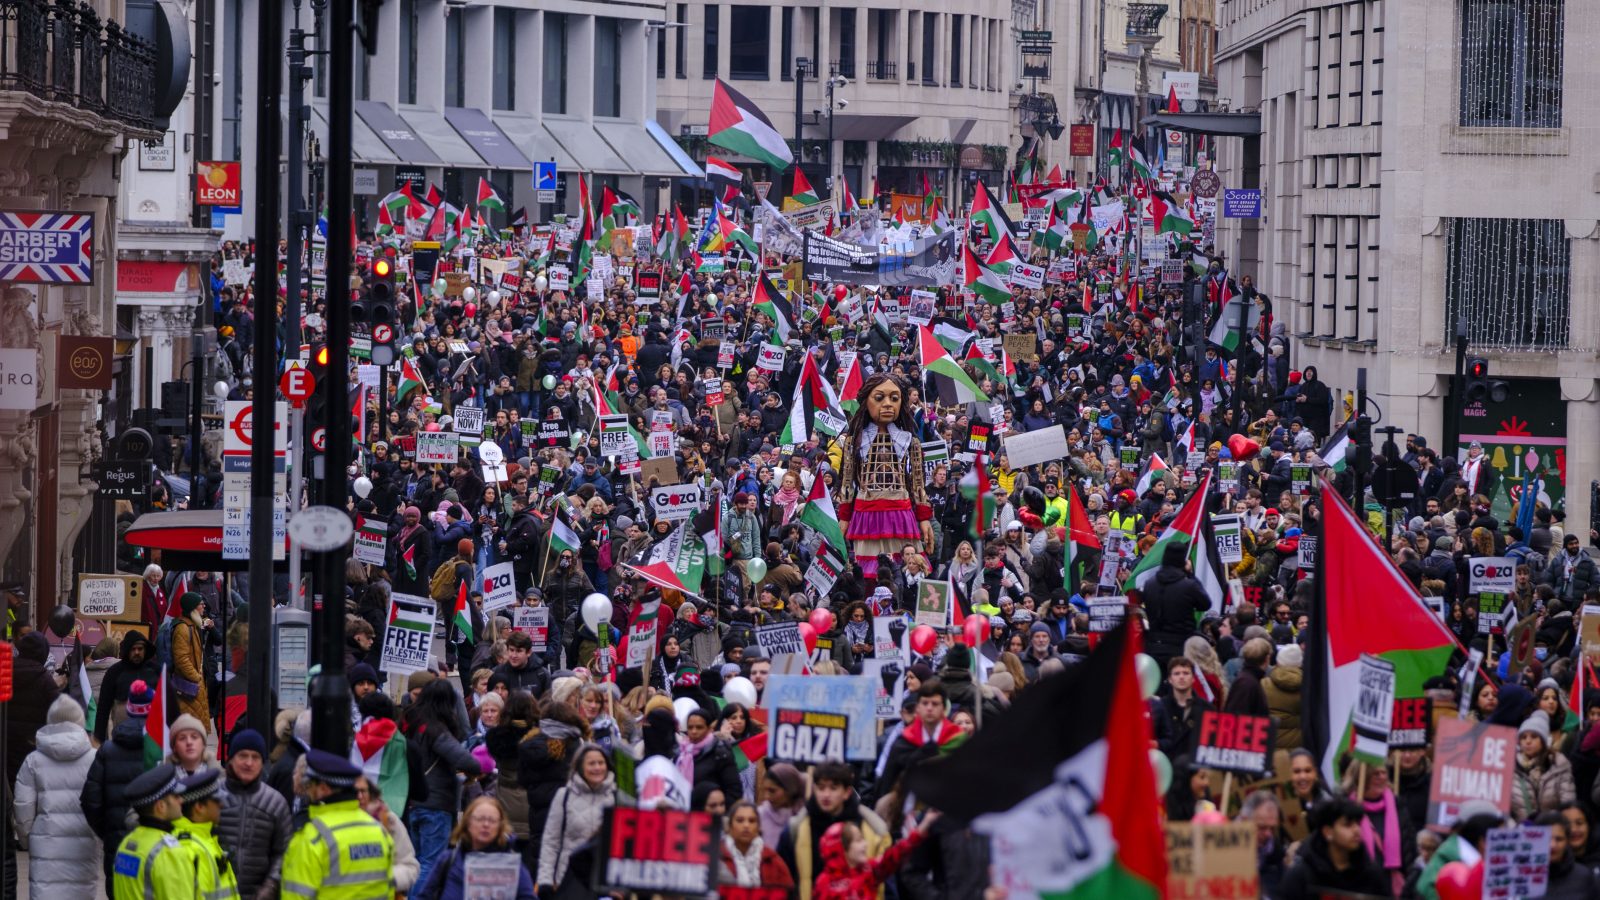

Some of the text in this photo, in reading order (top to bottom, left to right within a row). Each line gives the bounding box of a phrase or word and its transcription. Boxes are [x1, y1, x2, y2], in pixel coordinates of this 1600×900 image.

[200, 188, 236, 199] LEON
[1226, 191, 1260, 200] Scotts
[1, 231, 71, 248] ARBER
[808, 237, 848, 255] incomplete
[0, 247, 58, 263] SHOP
[808, 246, 819, 255] the
[821, 247, 850, 261] freedom
[860, 257, 873, 265] the
[551, 270, 567, 280] Gza
[1015, 265, 1041, 278] Gza
[503, 273, 521, 285] FREE
[640, 278, 658, 288] FREE
[702, 329, 724, 337] FREE
[760, 346, 782, 360] Gza
[289, 371, 306, 395] E
[455, 410, 481, 419] CEASEFIRE
[542, 422, 559, 430] Free
[971, 425, 989, 436] STOP
[106, 471, 136, 483] Regus
[656, 493, 696, 507] Gza
[359, 530, 383, 542] FREE
[1217, 534, 1240, 547] REE
[356, 538, 385, 549] PALESTINE
[1300, 542, 1317, 551] CEAS
[1473, 564, 1512, 579] Gza
[85, 580, 117, 588] WESTERN
[83, 605, 118, 613] GENOCIDE
[1090, 605, 1124, 616] FREEDOM
[385, 626, 430, 652] FREE
[758, 628, 802, 648] CEASEFIRE
[384, 646, 428, 661] PALESTINE
[1199, 711, 1271, 752] FREE
[1388, 729, 1426, 745] LESTINE
[776, 723, 845, 762] GAZA
[1196, 745, 1265, 772] PALESTINE
[1482, 737, 1508, 768] BE
[1439, 766, 1504, 803] HUMAN
[609, 807, 713, 864] FREE
[350, 843, 383, 860] POLICE
[605, 858, 710, 891] PALESTINE
